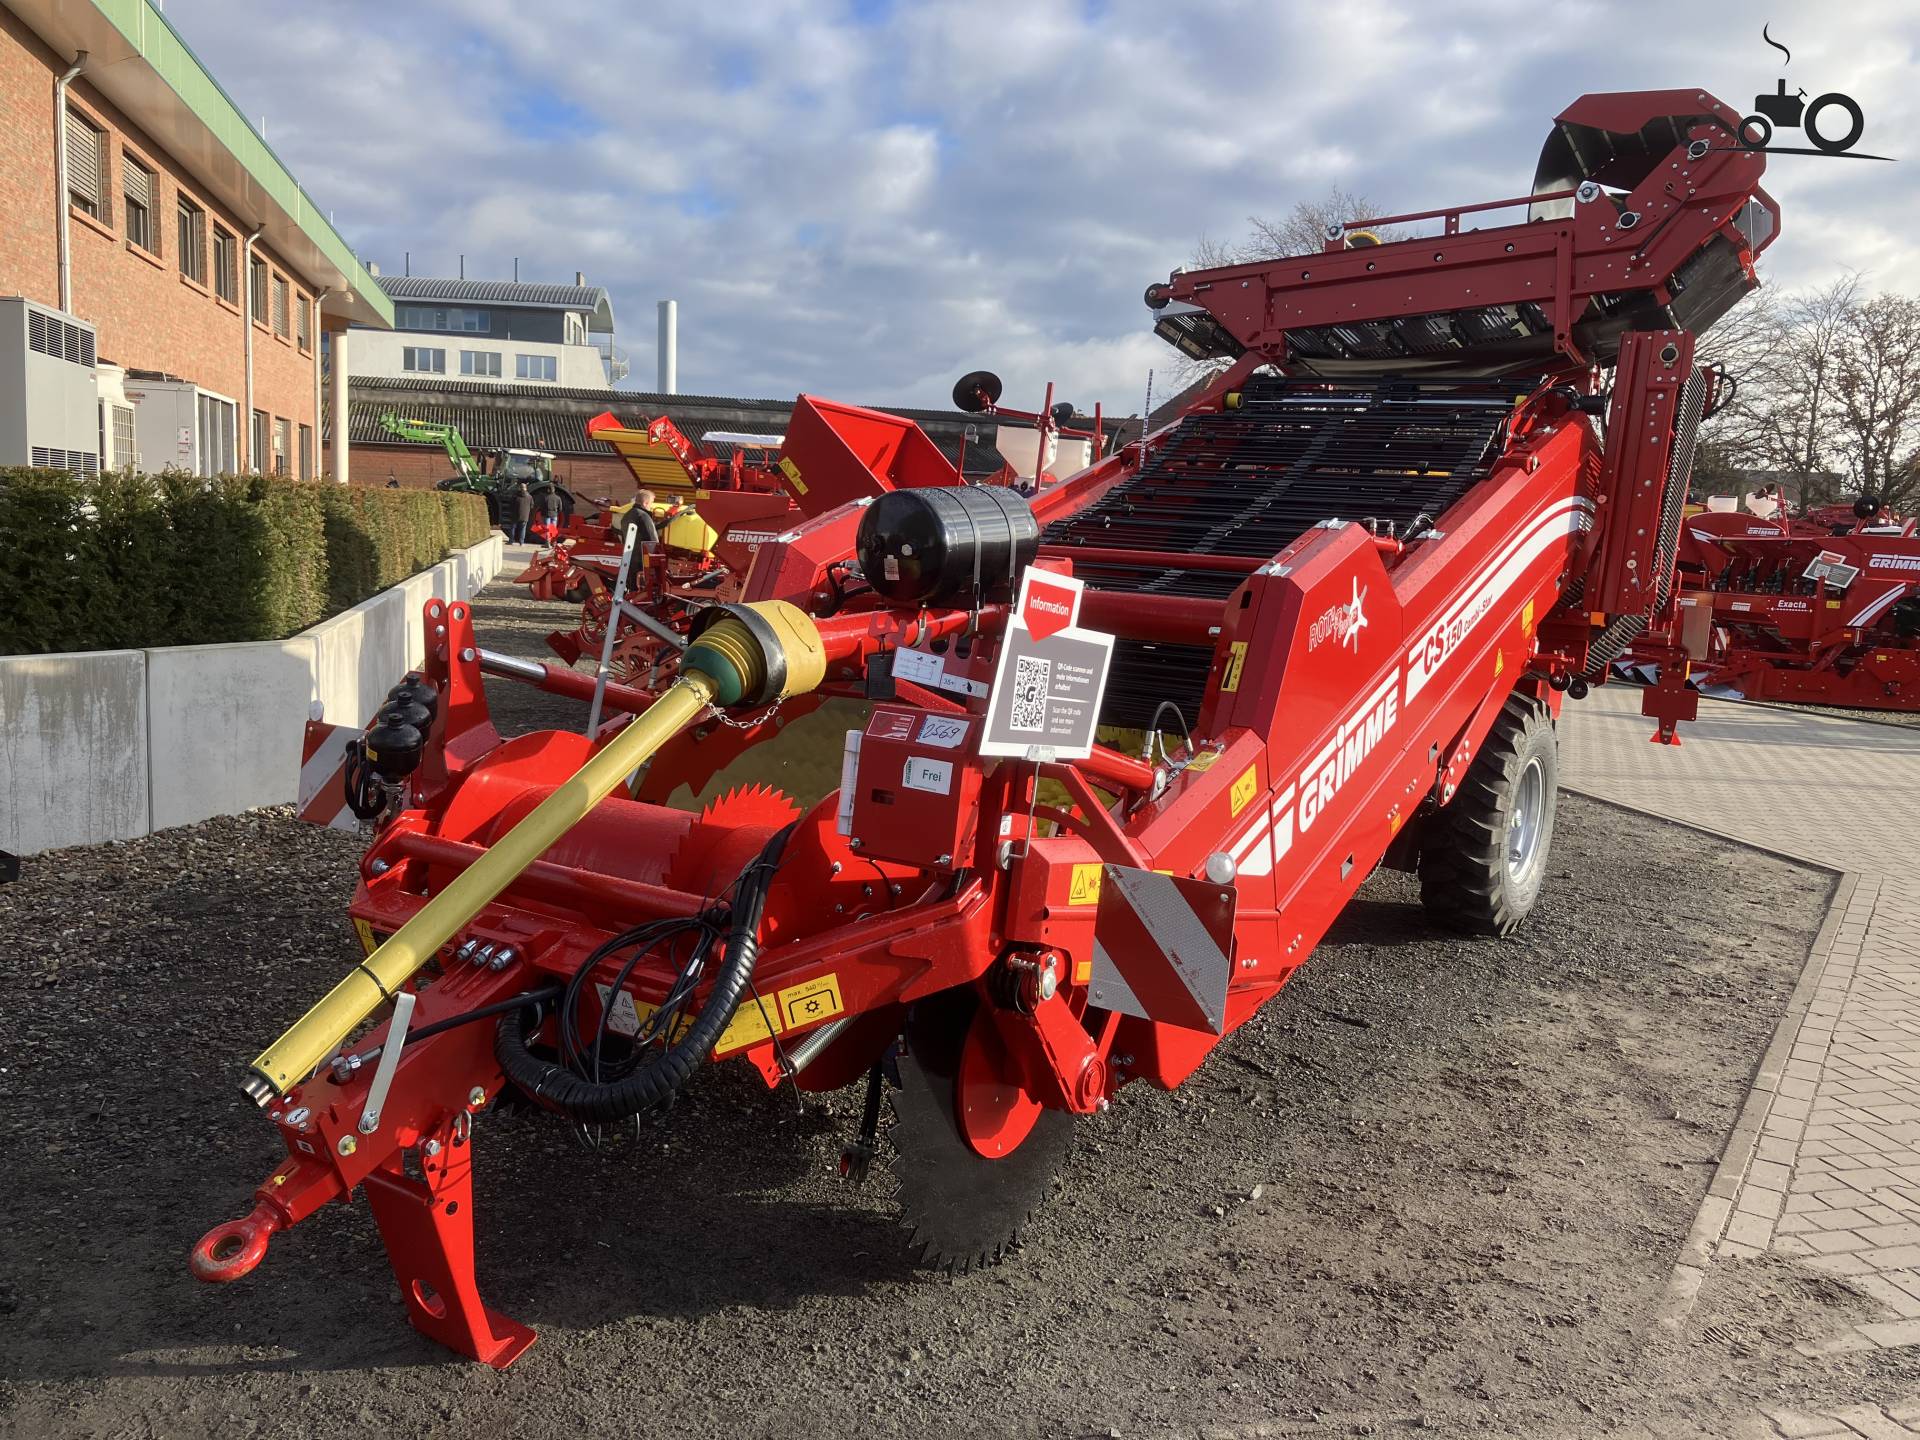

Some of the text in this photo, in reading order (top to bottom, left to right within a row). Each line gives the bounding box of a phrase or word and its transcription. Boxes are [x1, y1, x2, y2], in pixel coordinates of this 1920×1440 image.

[727, 530, 776, 543] GRIMM
[1030, 595, 1069, 616] Information
[1778, 600, 1807, 609] Exacta
[1424, 624, 1445, 675] CS
[1445, 619, 1463, 656] 150
[922, 723, 961, 739] 2569
[1299, 685, 1398, 833] GRIMME
[922, 769, 942, 782] Frei
